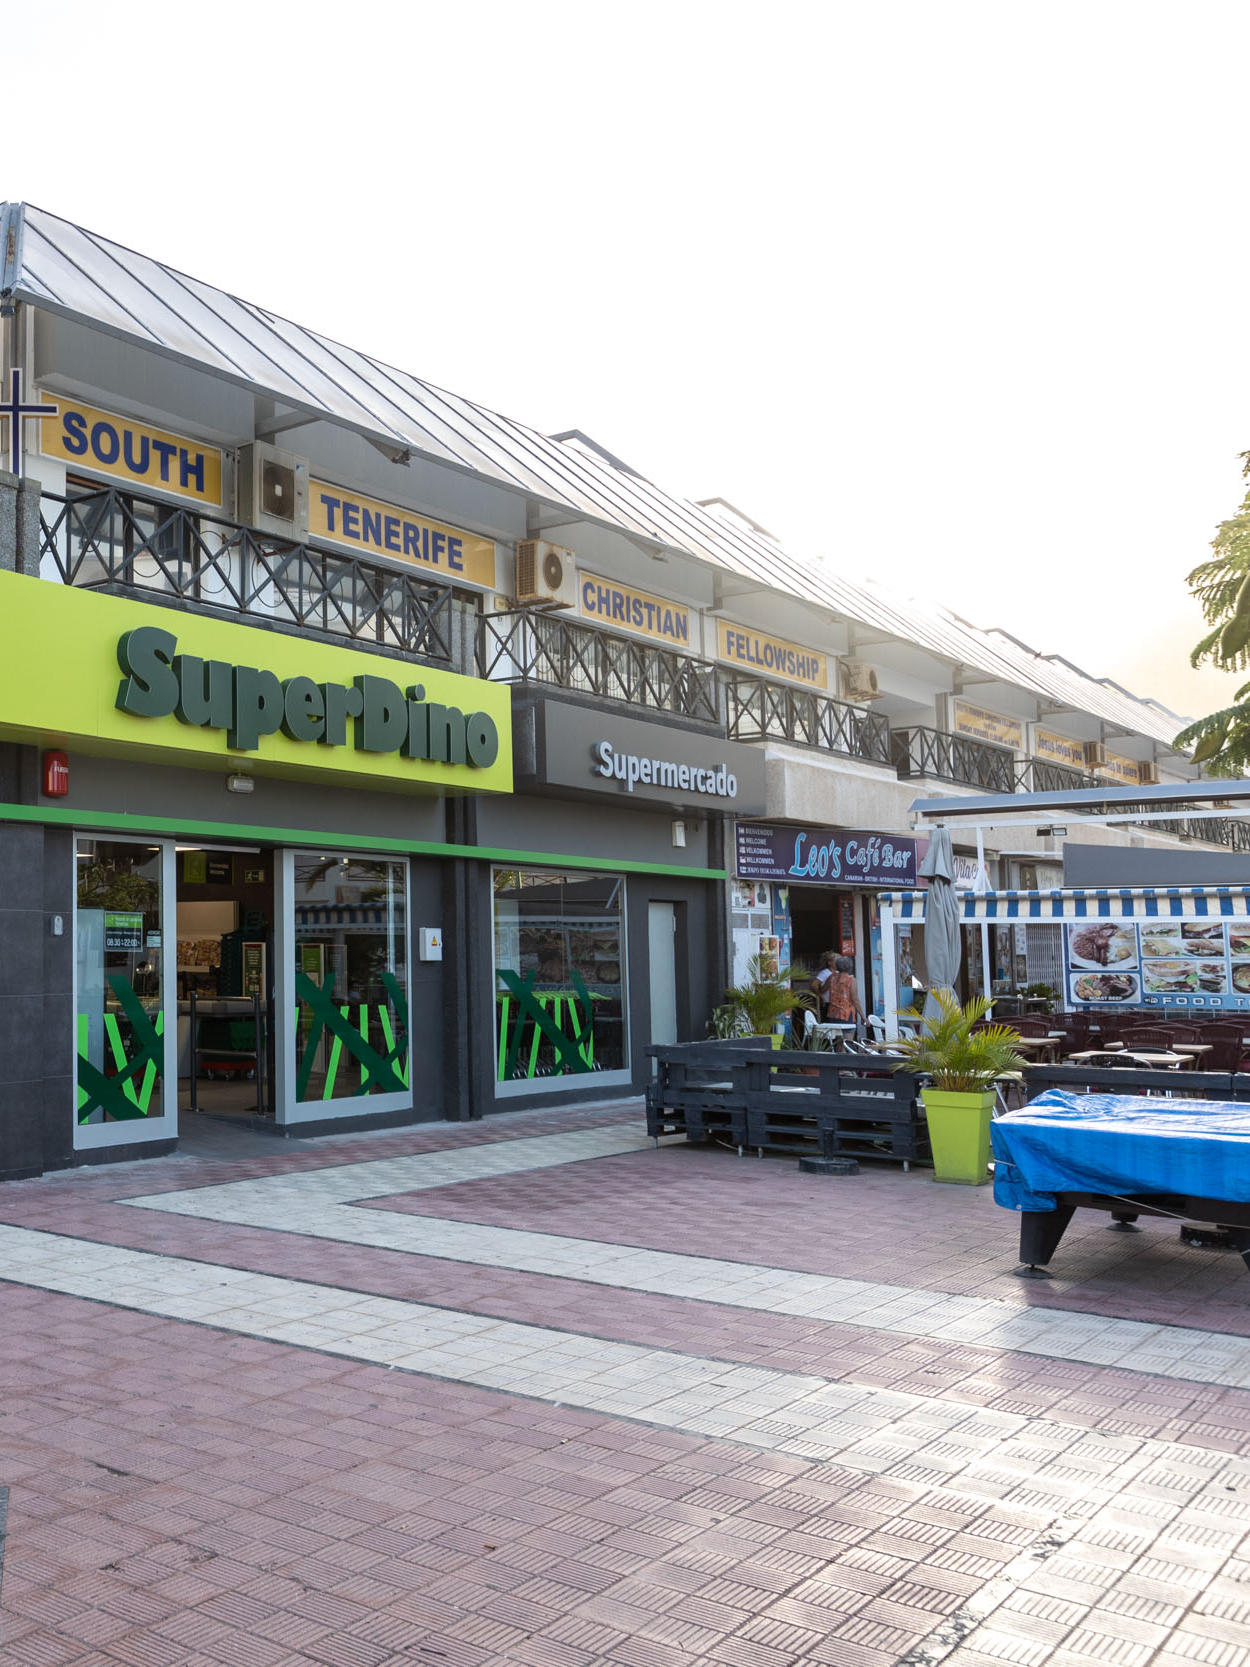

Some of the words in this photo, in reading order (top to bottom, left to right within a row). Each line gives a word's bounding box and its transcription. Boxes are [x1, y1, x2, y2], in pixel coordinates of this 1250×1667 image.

[62, 411, 204, 493] SOUTH
[320, 494, 463, 572] TENERIFE
[582, 581, 688, 641] CHRISTIAN
[726, 630, 819, 681] FELLOWSHIP
[116, 626, 498, 769] SuperDino
[597, 741, 738, 798] Supermercado
[789, 832, 842, 878] Leo's
[846, 837, 881, 873] Café
[882, 843, 912, 869] Bar
[1163, 996, 1223, 1006] FOOD
